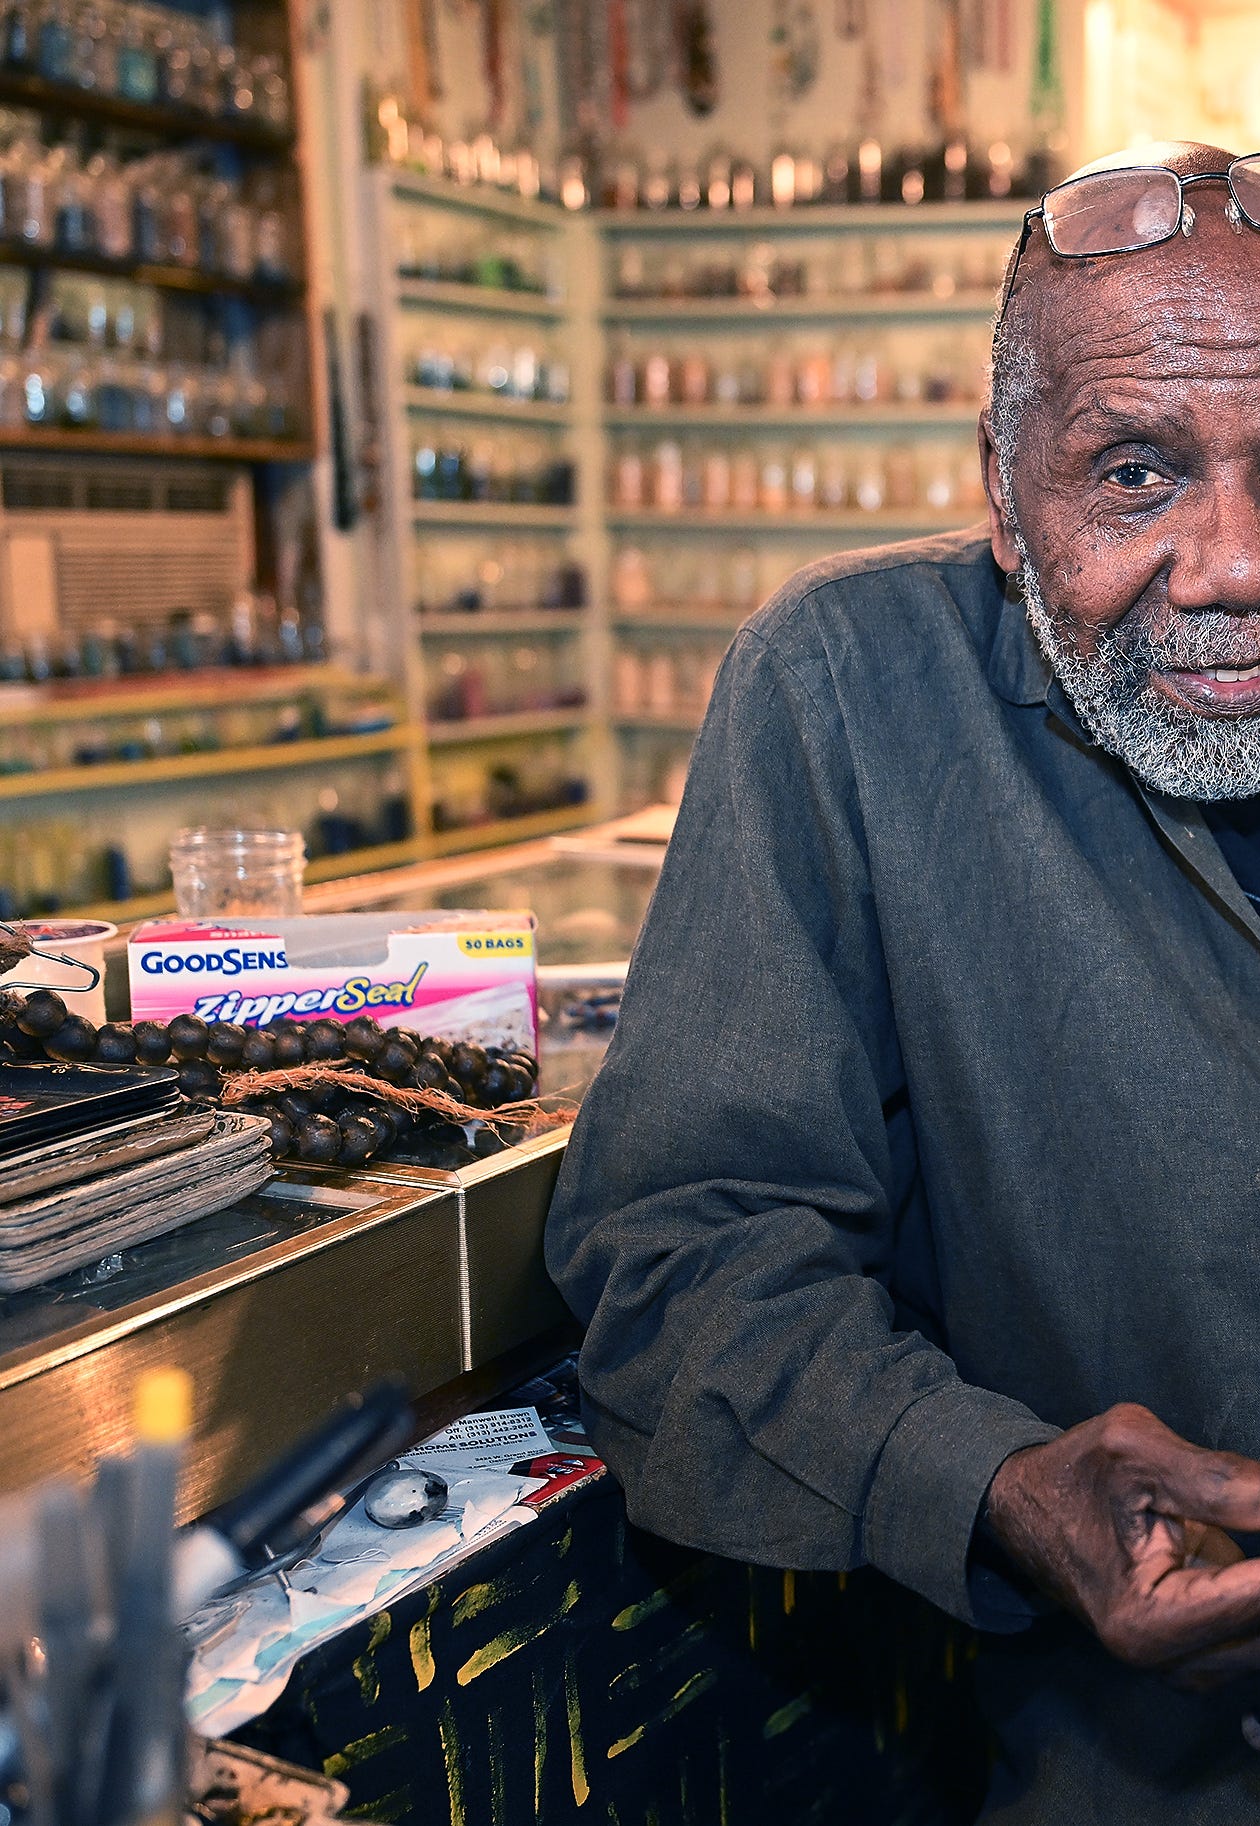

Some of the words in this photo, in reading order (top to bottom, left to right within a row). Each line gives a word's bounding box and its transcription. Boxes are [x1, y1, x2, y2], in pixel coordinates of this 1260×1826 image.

[465, 939, 482, 949] 50
[485, 938, 524, 949] BAGS
[458, 1415, 497, 1426] Manwell
[499, 1411, 530, 1420] Brown
[465, 1423, 489, 1433] (313)
[467, 1429, 491, 1440] (313)
[414, 1442, 457, 1452] HOME
[459, 1430, 538, 1448] SOLUTIONS
